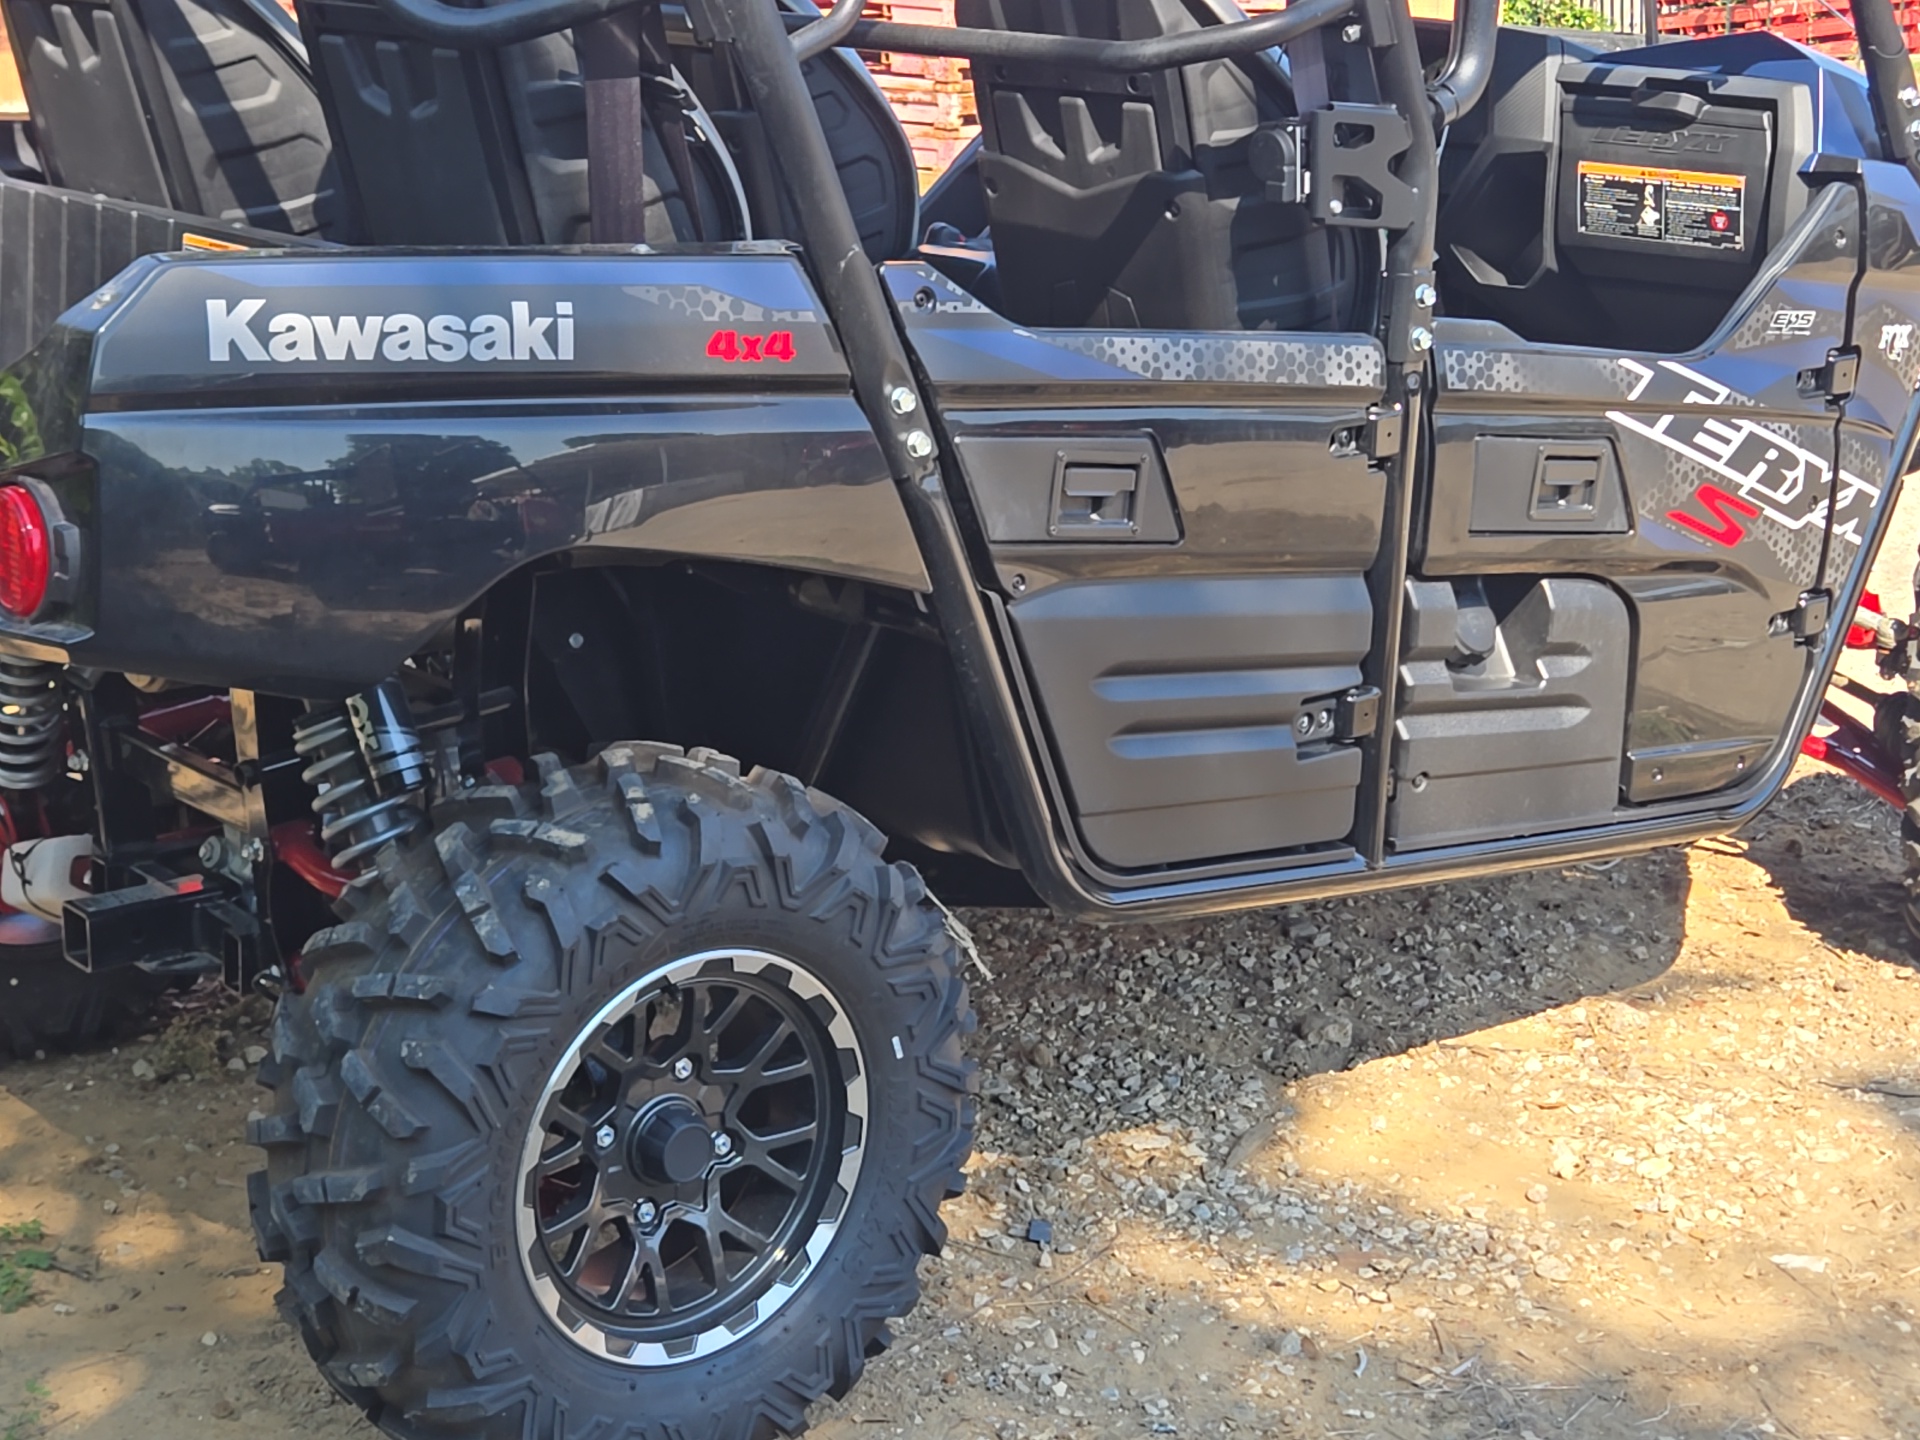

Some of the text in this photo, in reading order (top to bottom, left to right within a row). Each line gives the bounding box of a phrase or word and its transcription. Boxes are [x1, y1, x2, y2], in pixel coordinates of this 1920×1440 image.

[205, 298, 575, 363] Kawasaki
[1772, 311, 1814, 329] EPS
[706, 330, 797, 363] 4x4
[1878, 323, 1913, 362] FOX
[1665, 483, 1760, 549] S
